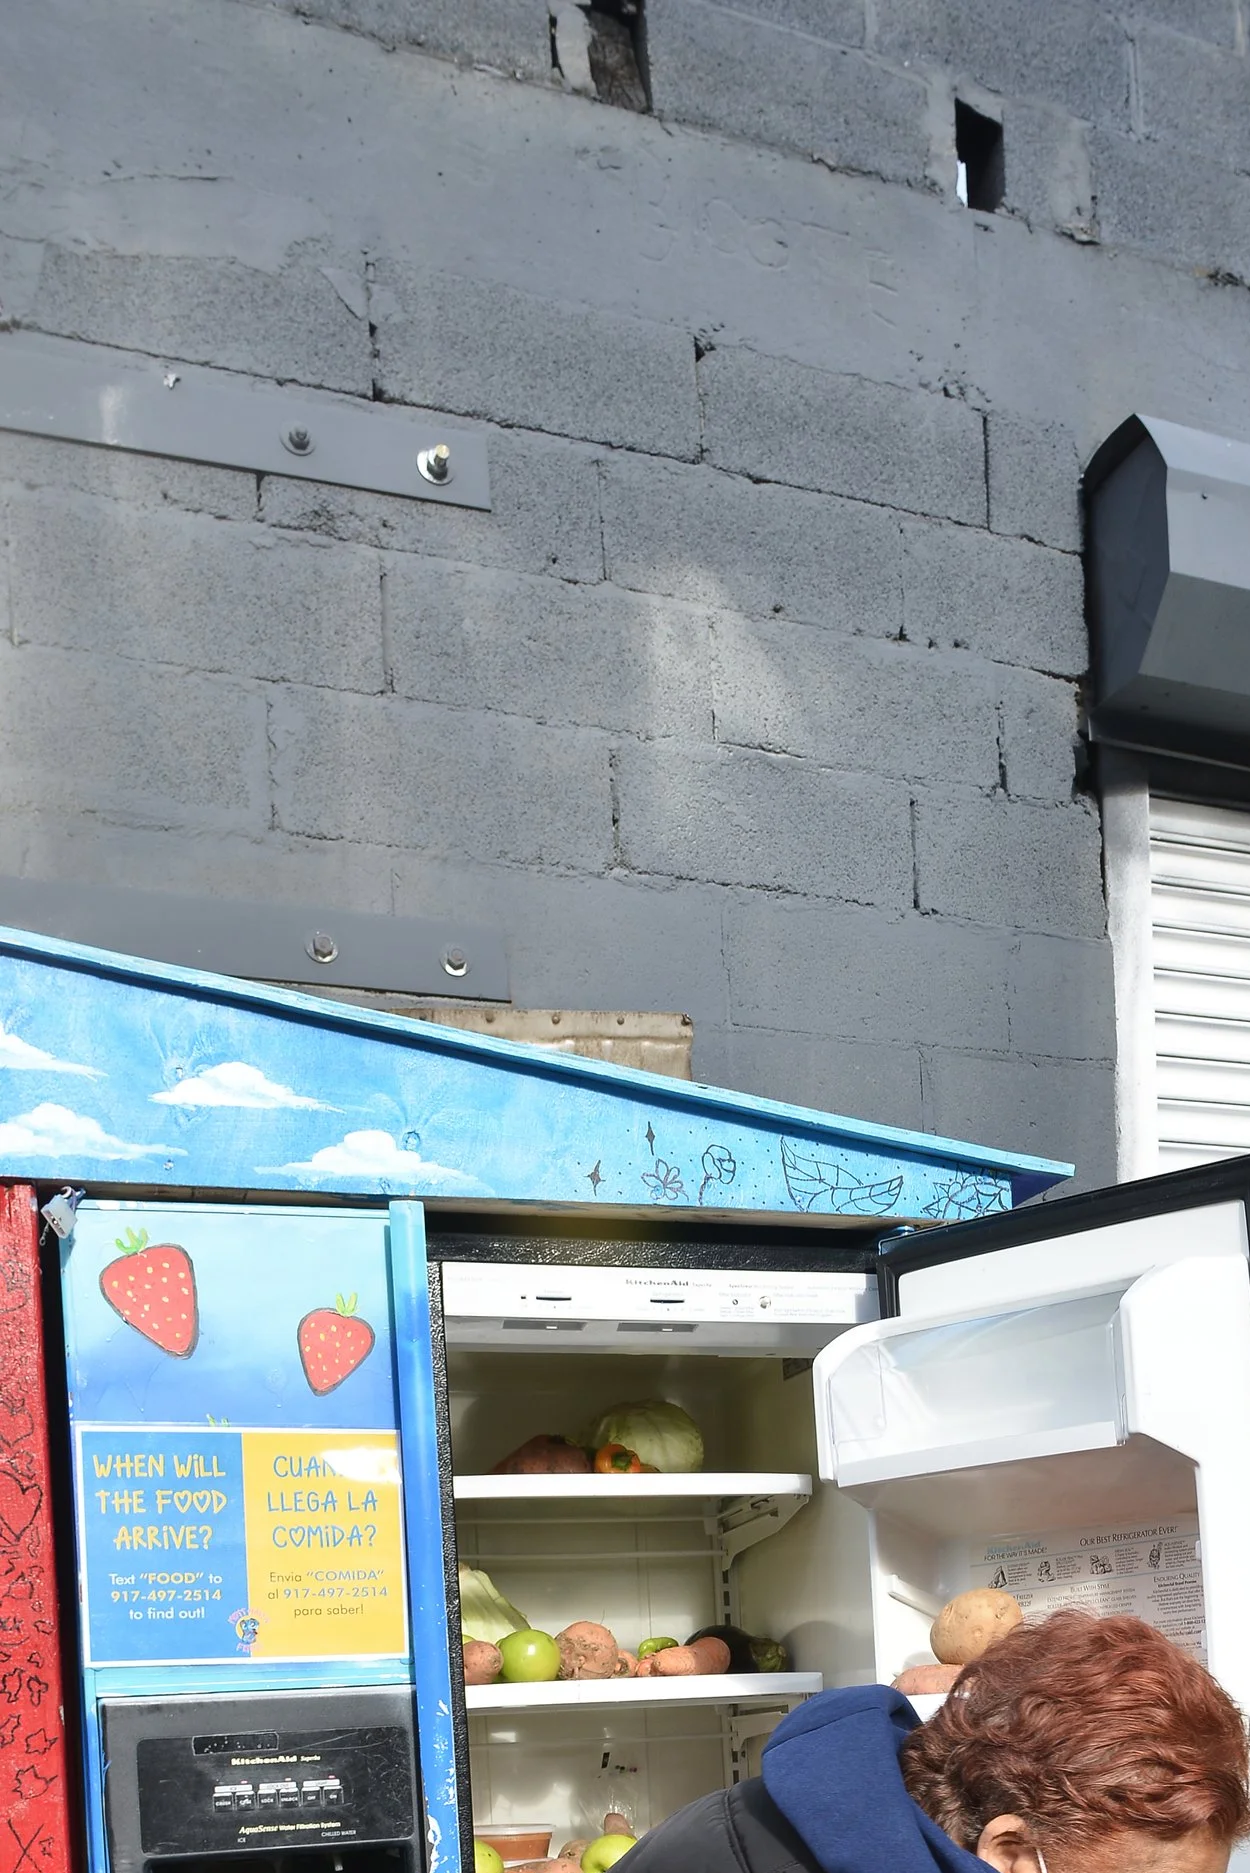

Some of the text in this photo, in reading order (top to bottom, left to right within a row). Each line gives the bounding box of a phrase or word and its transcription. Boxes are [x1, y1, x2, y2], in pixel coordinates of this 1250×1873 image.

[93, 1454, 165, 1478] WHEN
[95, 1490, 227, 1514] THE FOOD
[267, 1489, 378, 1512] LLEGA LA
[1080, 1526, 1177, 1547] OUR BEST REFRIGERATOR EVER!
[108, 1573, 136, 1586] Text
[208, 1572, 222, 1584] to
[270, 1572, 302, 1583] Envia
[110, 1589, 222, 1603] 917-497-2514
[268, 1586, 388, 1600] al 917-497-2514
[128, 1607, 205, 1620] to find out!
[294, 1604, 364, 1618] para saber!
[231, 1756, 298, 1766] KitchenAid
[238, 1825, 279, 1835] AquaSense
